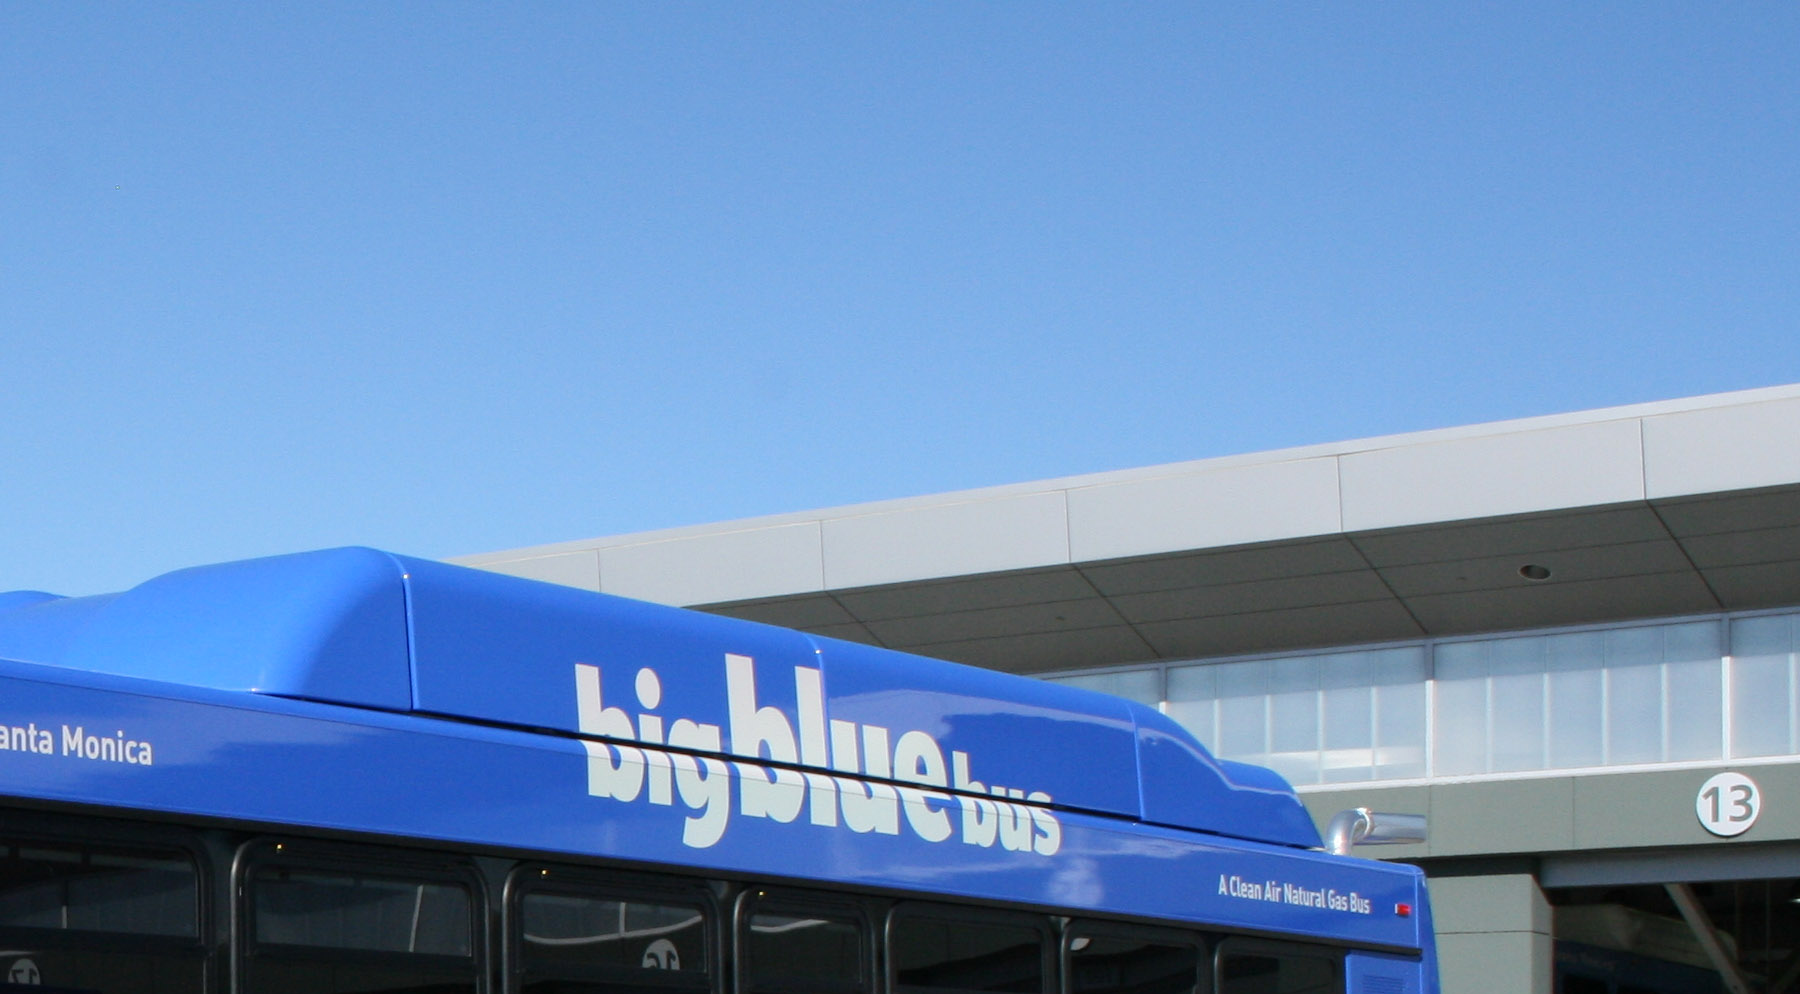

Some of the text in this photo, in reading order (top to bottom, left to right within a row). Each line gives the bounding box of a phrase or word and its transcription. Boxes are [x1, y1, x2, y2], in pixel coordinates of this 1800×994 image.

[61, 725, 153, 766] Monica
[1702, 784, 1753, 823] 13
[1218, 873, 1371, 915] A Clean Air Natural Gas Bus
